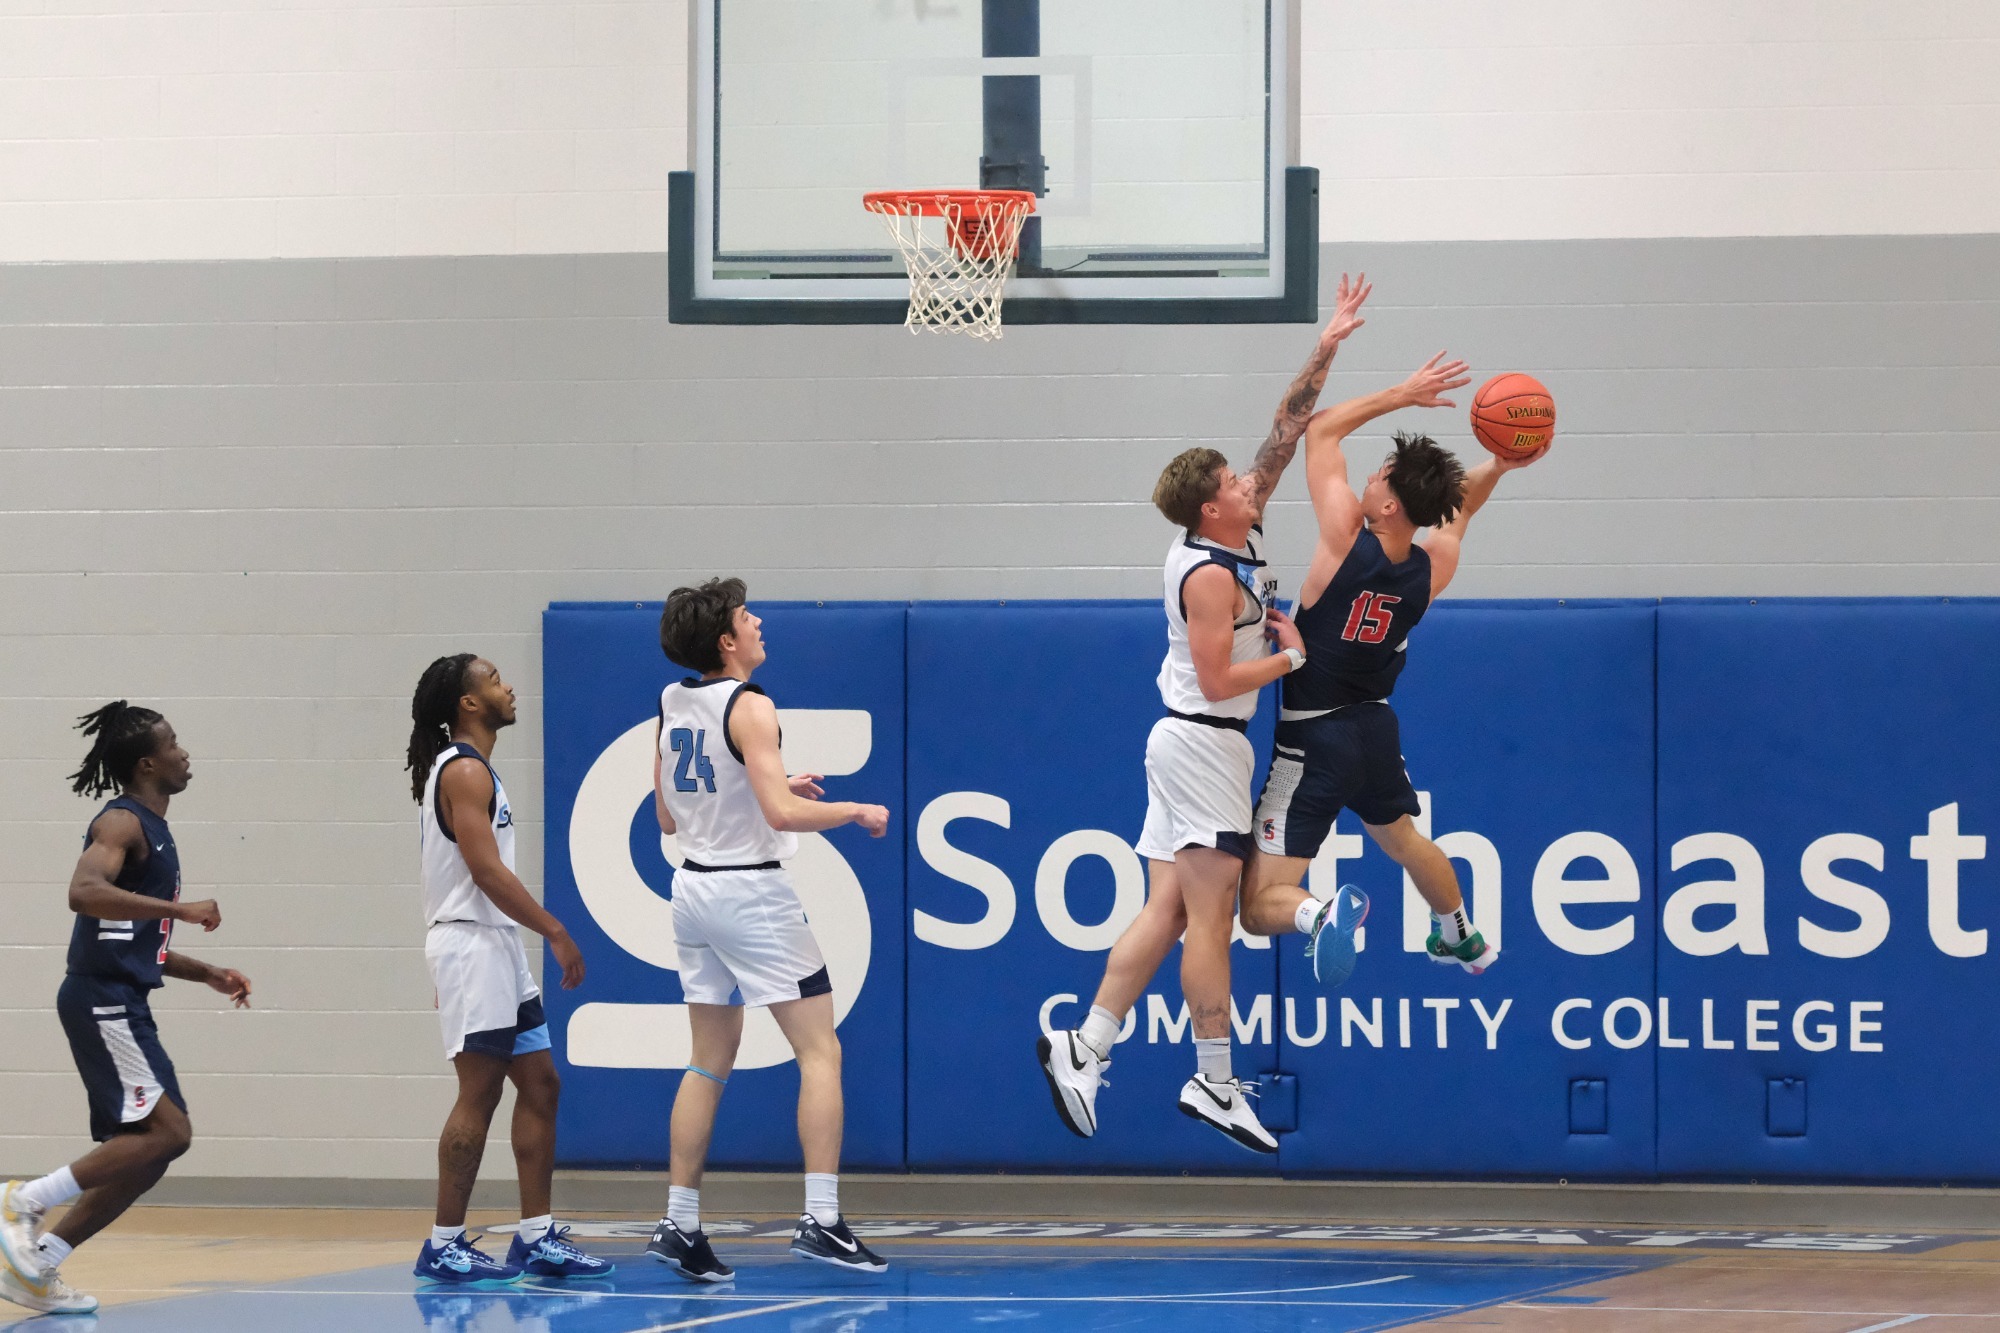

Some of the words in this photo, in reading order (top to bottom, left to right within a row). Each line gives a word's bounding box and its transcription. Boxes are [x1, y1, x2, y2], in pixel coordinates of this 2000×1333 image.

[1341, 590, 1402, 644] 15
[669, 727, 717, 793] 24
[1551, 996, 1884, 1052] COLLEGE
